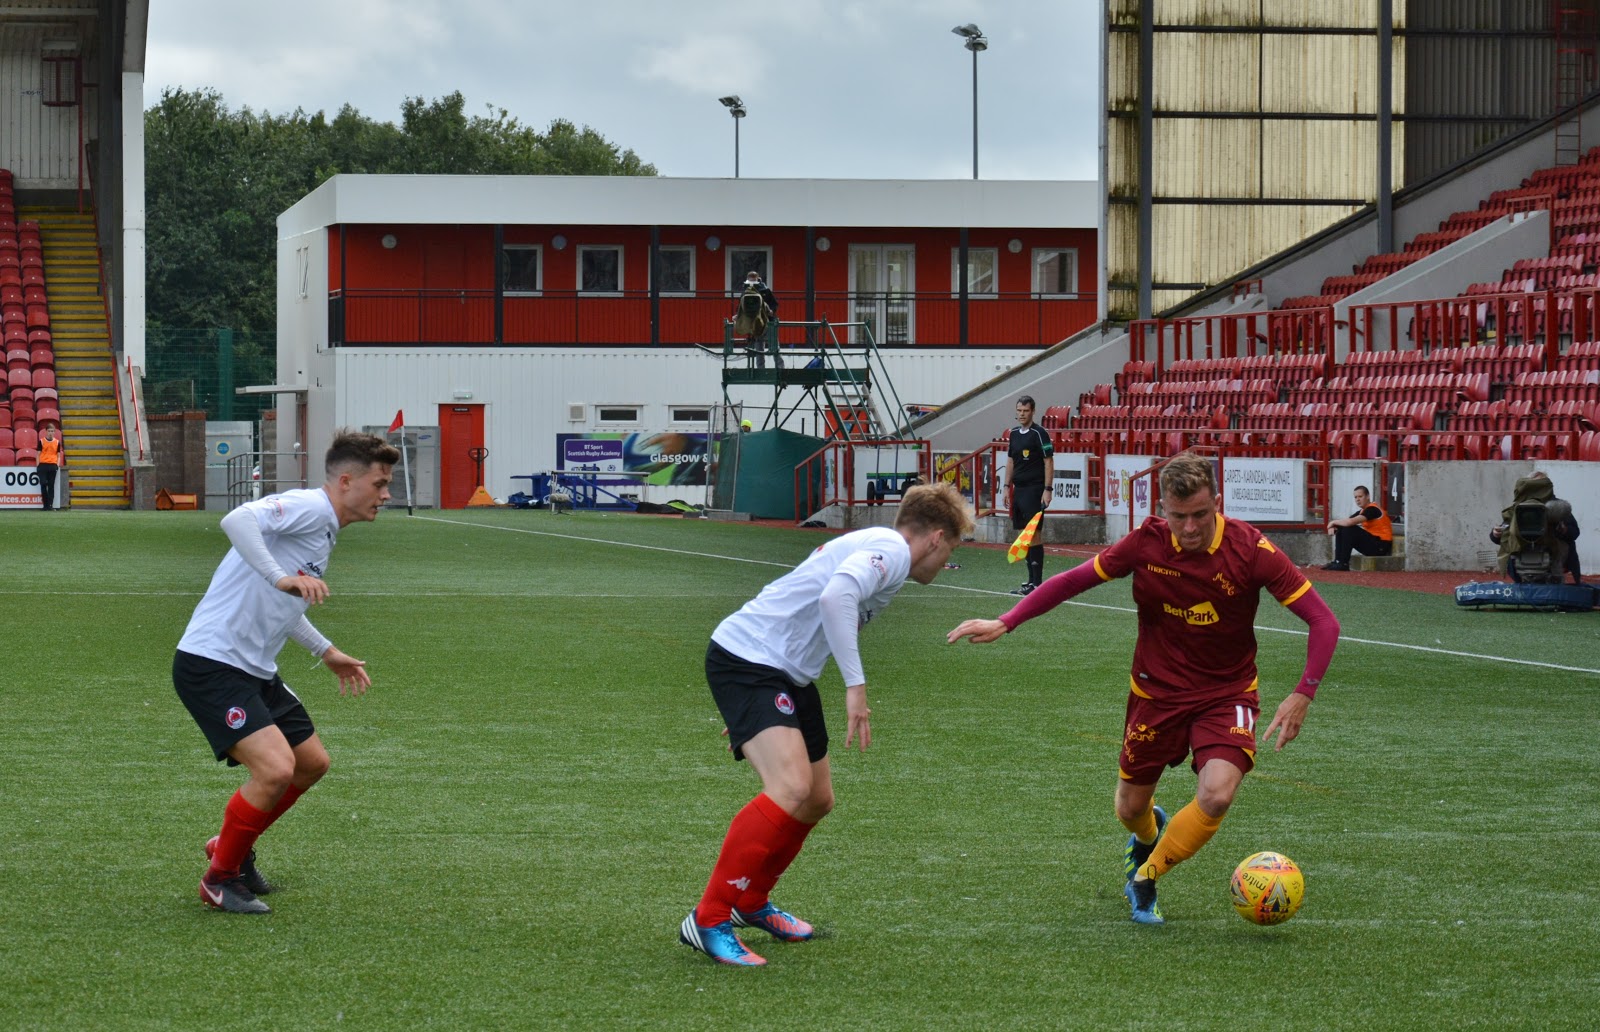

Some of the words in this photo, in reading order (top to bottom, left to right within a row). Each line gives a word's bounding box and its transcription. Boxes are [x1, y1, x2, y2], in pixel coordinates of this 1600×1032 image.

[650, 453, 699, 465] Glasgow
[5, 471, 40, 486] 006
[983, 465, 988, 484] 2
[1065, 484, 1080, 499] 8343
[1391, 477, 1398, 502] 4
[306, 562, 323, 577] ADV
[1147, 563, 1181, 577] macron
[1235, 705, 1254, 733] 11
[1230, 726, 1253, 738] mac
[1242, 872, 1267, 891] mitre
